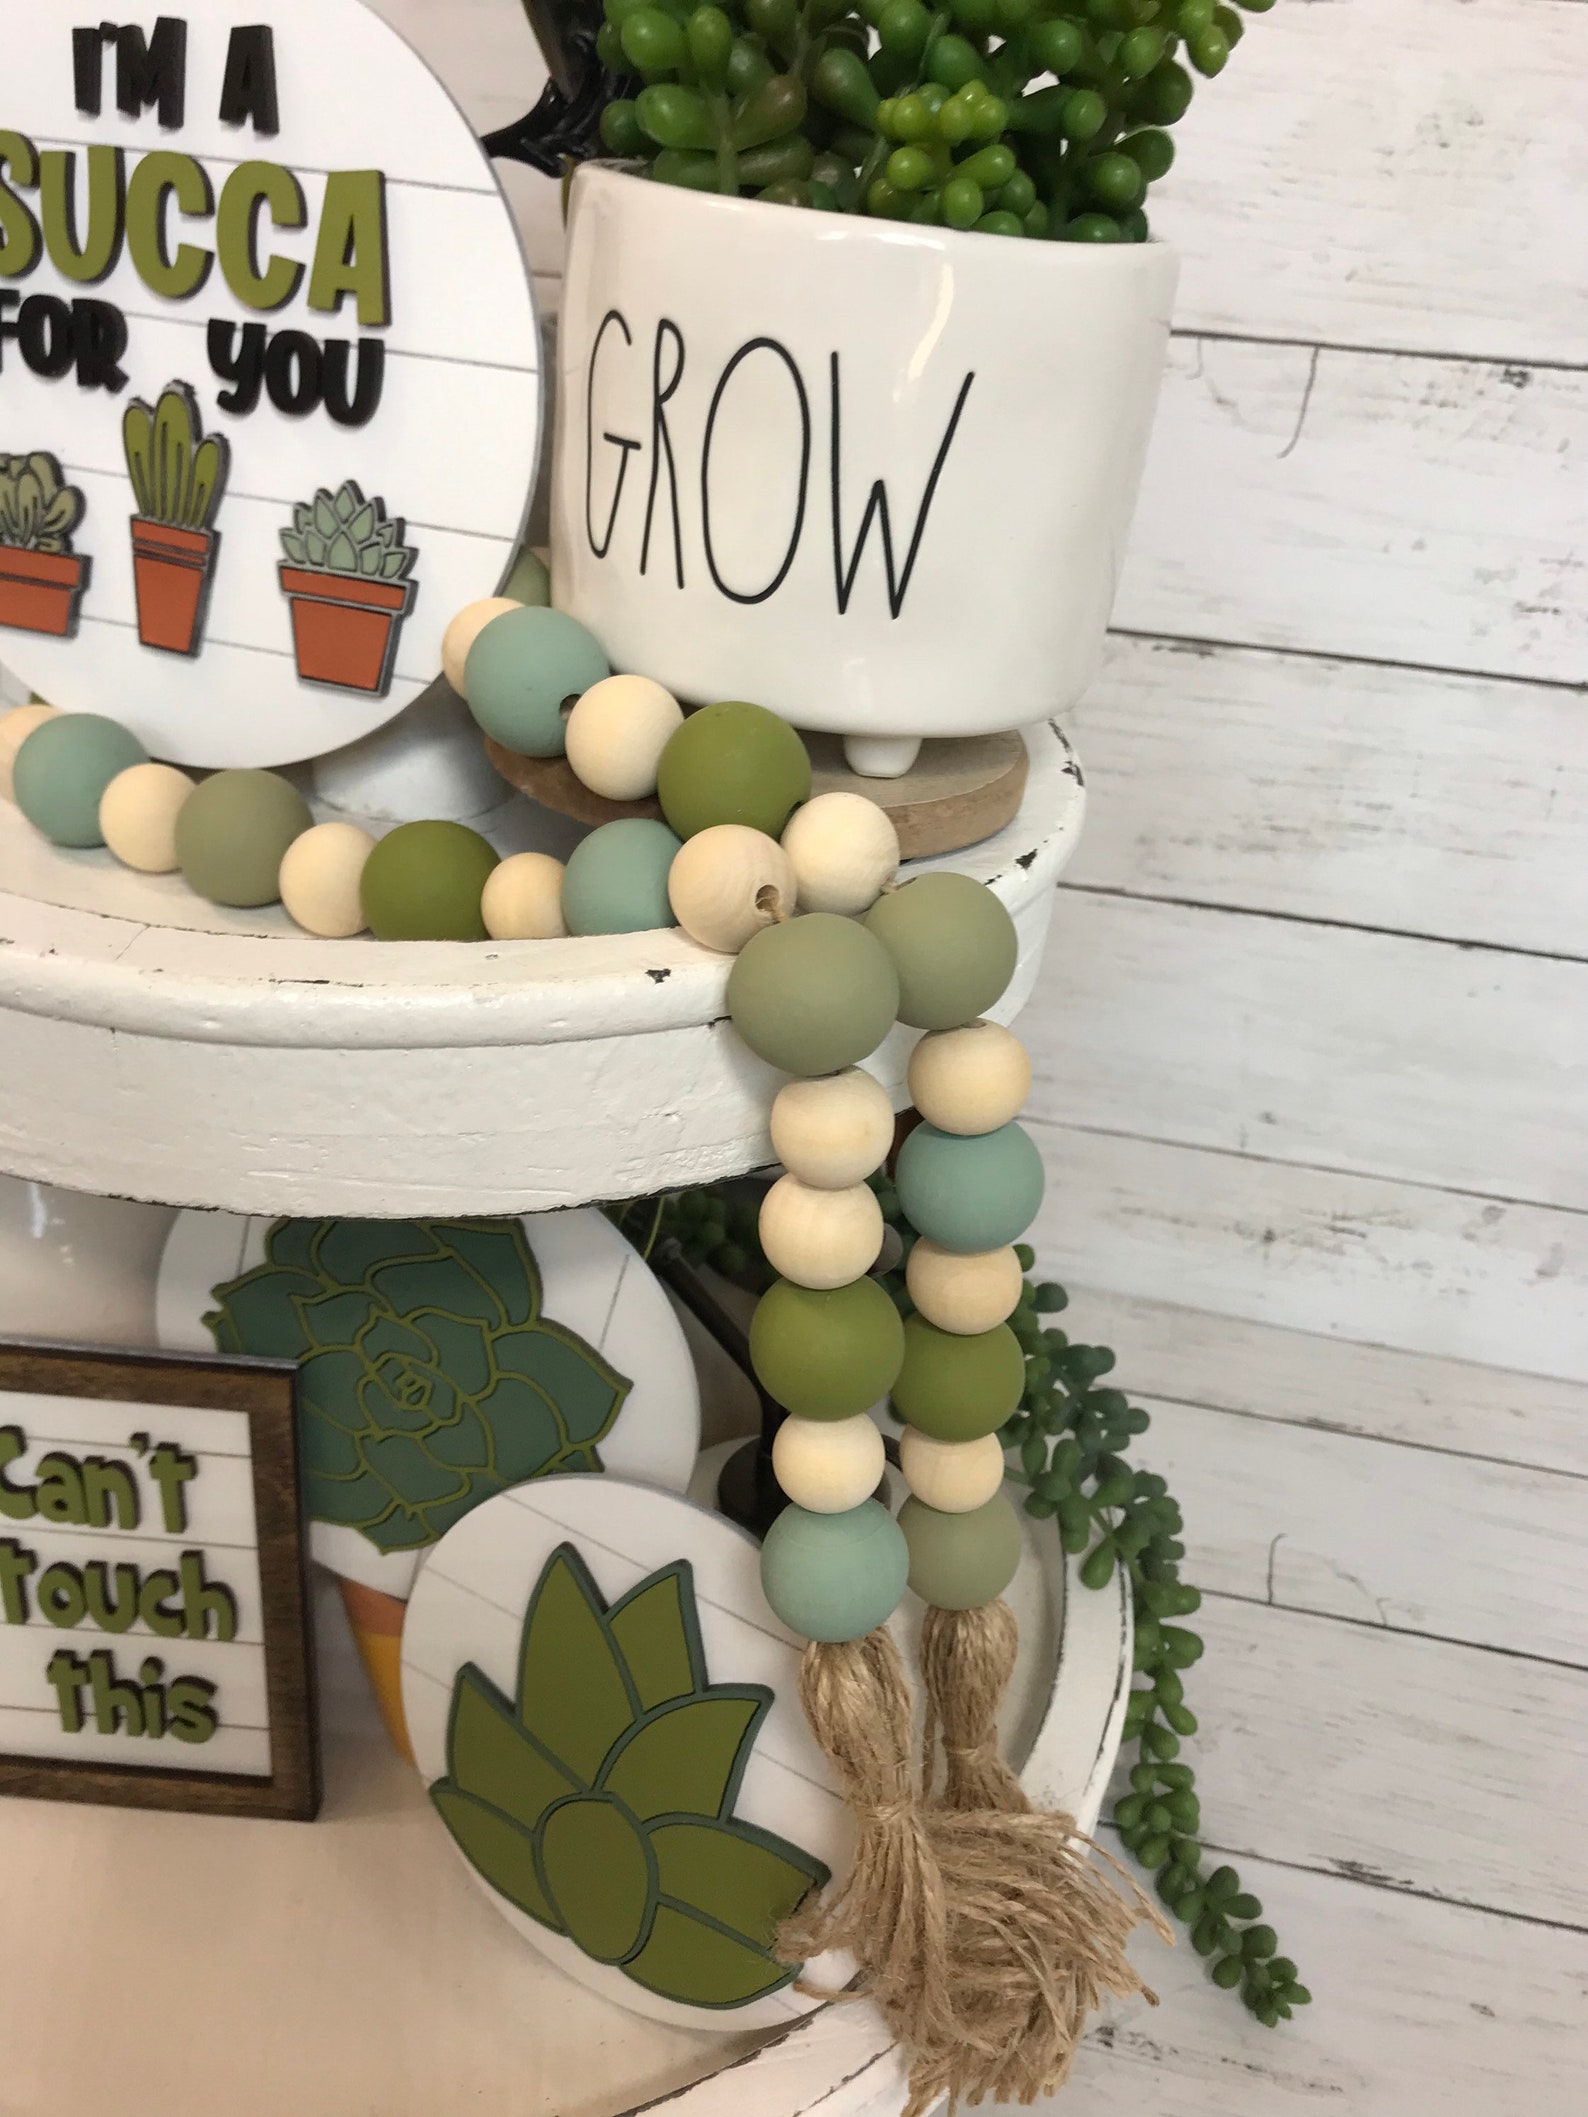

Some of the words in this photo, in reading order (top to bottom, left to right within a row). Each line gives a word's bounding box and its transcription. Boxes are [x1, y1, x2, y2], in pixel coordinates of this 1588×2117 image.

[72, 17, 188, 131] I'M
[219, 25, 280, 136] A
[0, 130, 390, 327] SUCCA
[586, 310, 976, 620] GROW
[0, 1537, 237, 1641] touch
[46, 1649, 218, 1743] this
